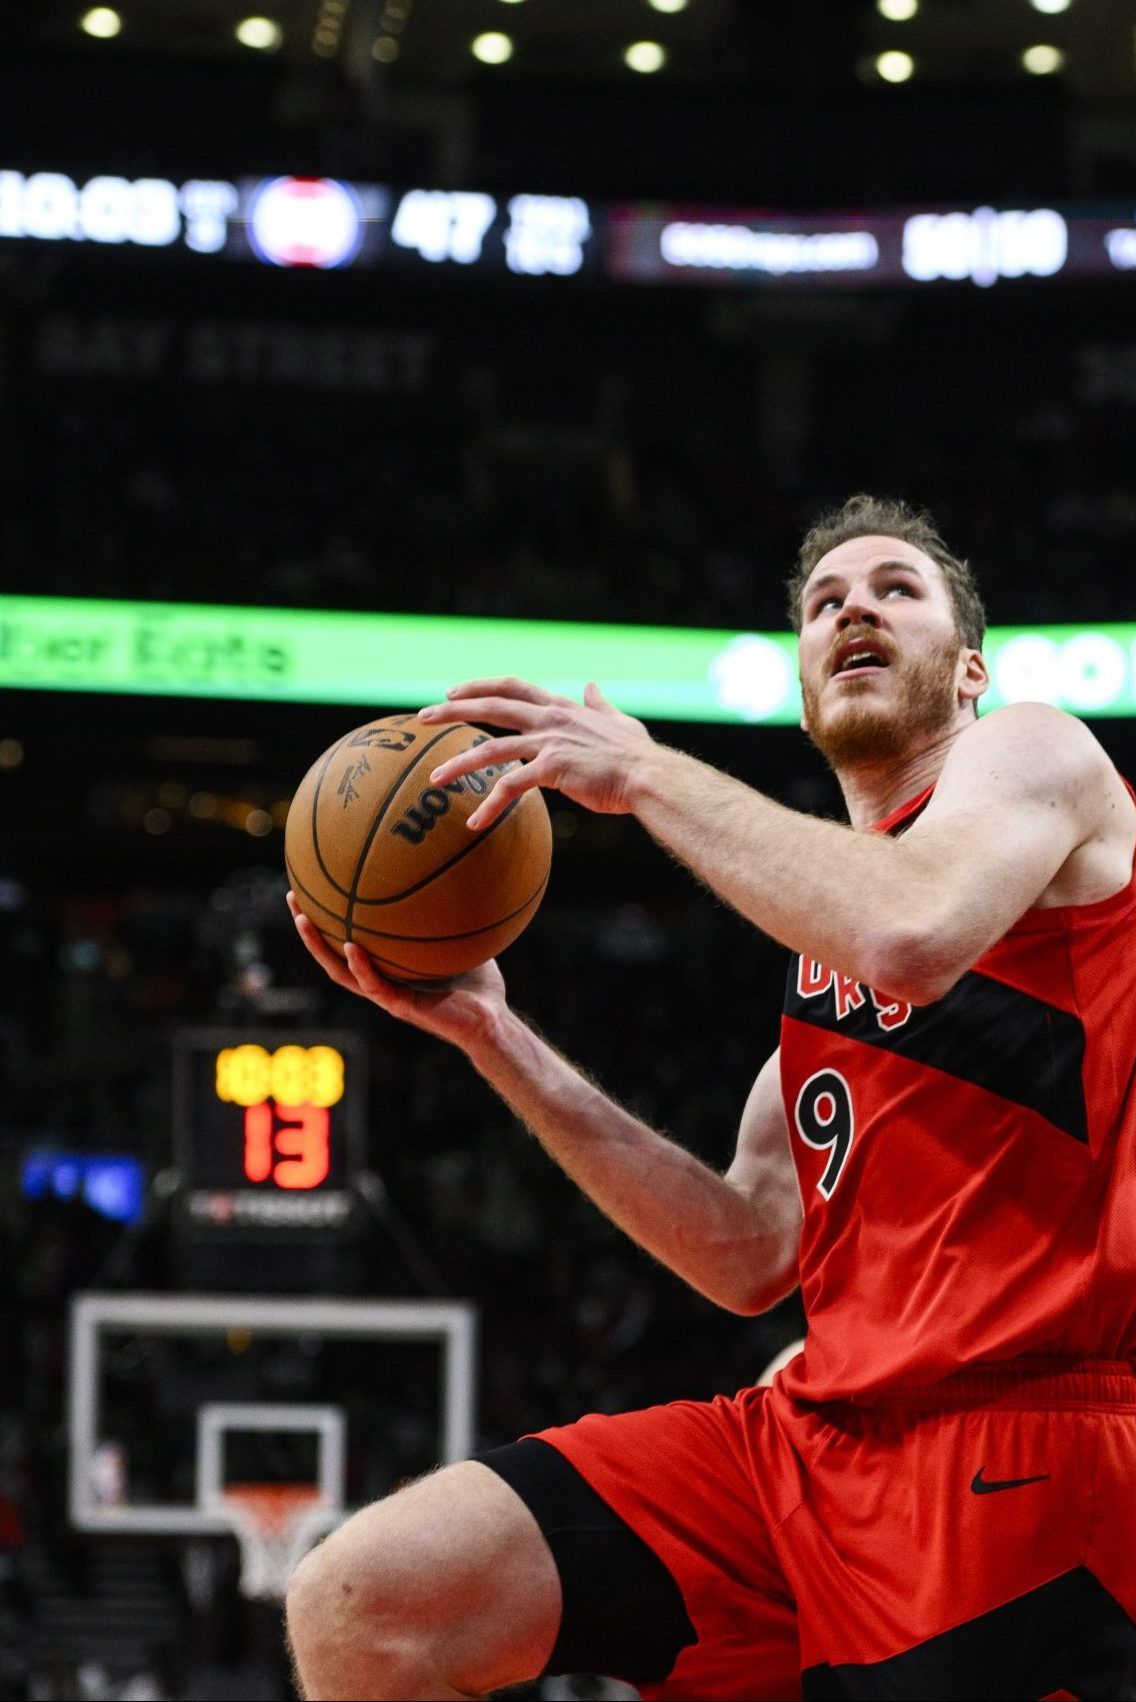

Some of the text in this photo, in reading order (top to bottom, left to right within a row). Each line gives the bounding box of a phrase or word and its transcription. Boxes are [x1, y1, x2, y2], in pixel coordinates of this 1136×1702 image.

[0, 616, 108, 676] ber
[244, 1098, 330, 1190] 13
[795, 1067, 854, 1201] 9
